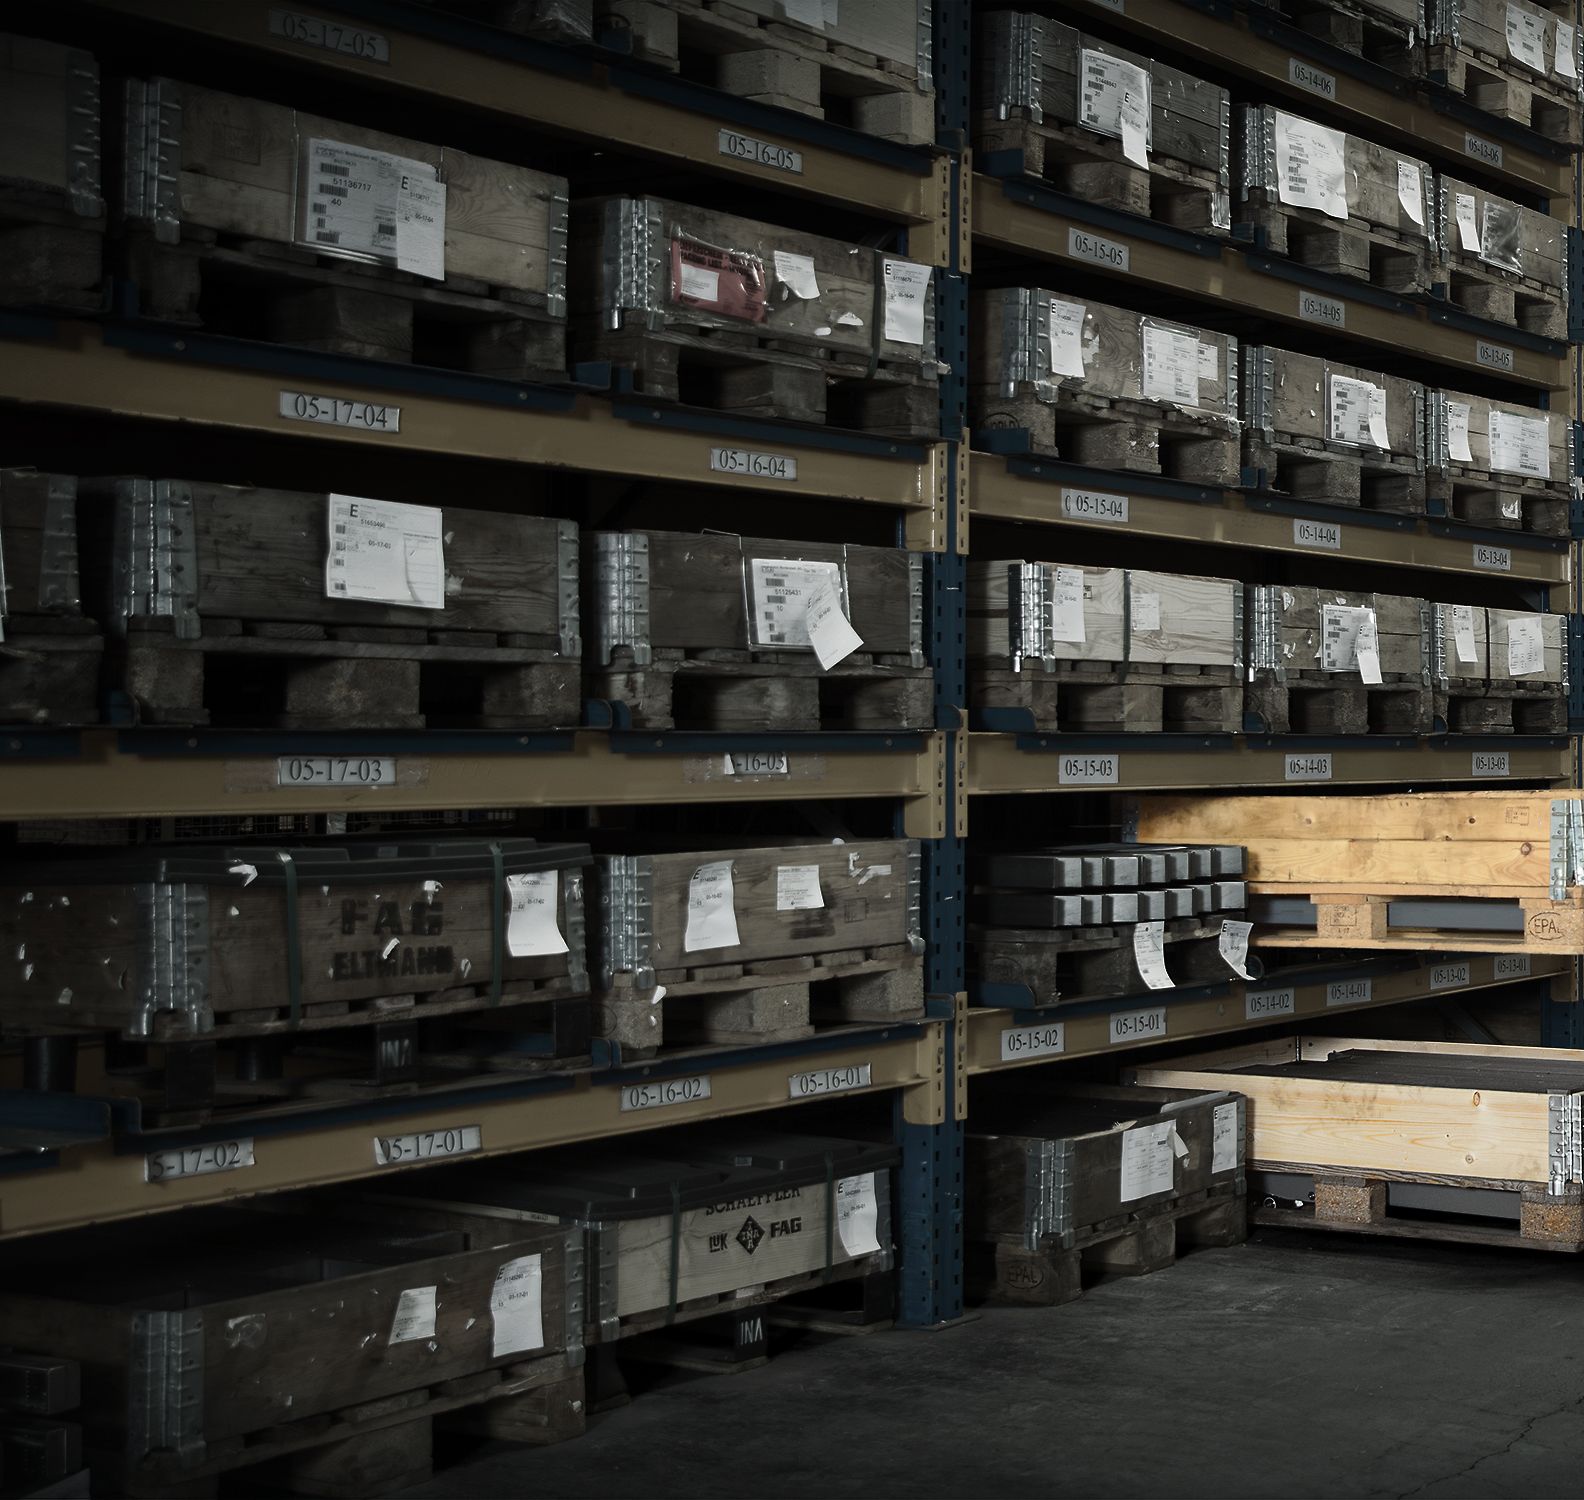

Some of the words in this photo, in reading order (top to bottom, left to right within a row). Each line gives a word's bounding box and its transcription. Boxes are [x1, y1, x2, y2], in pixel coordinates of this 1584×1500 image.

[282, 13, 378, 58] 05-17-05
[1294, 64, 1331, 94] 05-14-06
[728, 133, 794, 169] 05-16-05
[1468, 138, 1499, 162] 05-13-06
[401, 176, 409, 190] E
[331, 198, 342, 206] 40
[1075, 234, 1123, 265] 05-15-05
[885, 263, 892, 275] E
[1051, 302, 1057, 313] E
[1304, 299, 1341, 321] 05-14-05
[1480, 346, 1510, 367] 05-13-05
[295, 393, 388, 428] 05-17-04
[720, 449, 787, 477] 05-16-04
[350, 503, 359, 517] E
[1076, 496, 1123, 517] 05-15-04
[1299, 524, 1337, 544] 05-14-04
[1478, 549, 1507, 566] 05-13-04
[289, 758, 383, 782] 05-17-03
[733, 751, 784, 771] -16-03
[1065, 759, 1112, 776] 05-15-03
[1290, 759, 1327, 774] 05-14-03
[1475, 756, 1505, 770] 05-13-03
[693, 868, 702, 880] E
[341, 898, 444, 936] FAG
[1222, 922, 1229, 933] E
[1434, 968, 1466, 983] 05-13-02
[1497, 958, 1526, 973] 05-13-01
[1331, 983, 1366, 1000] 05-14-01
[1251, 994, 1289, 1012] 05-14-02
[1116, 1014, 1160, 1035] 05-15-01
[1009, 1030, 1058, 1051] 05-15-02
[800, 1066, 861, 1095] 05-16-01
[630, 1079, 702, 1107] 05-16-02
[149, 1141, 241, 1179] 5-17-02
[837, 1182, 844, 1194] E
[770, 1216, 802, 1239] FAG
[497, 1268, 505, 1280] E
[1008, 1266, 1038, 1284] EPAL
[740, 1317, 763, 1346] INA
